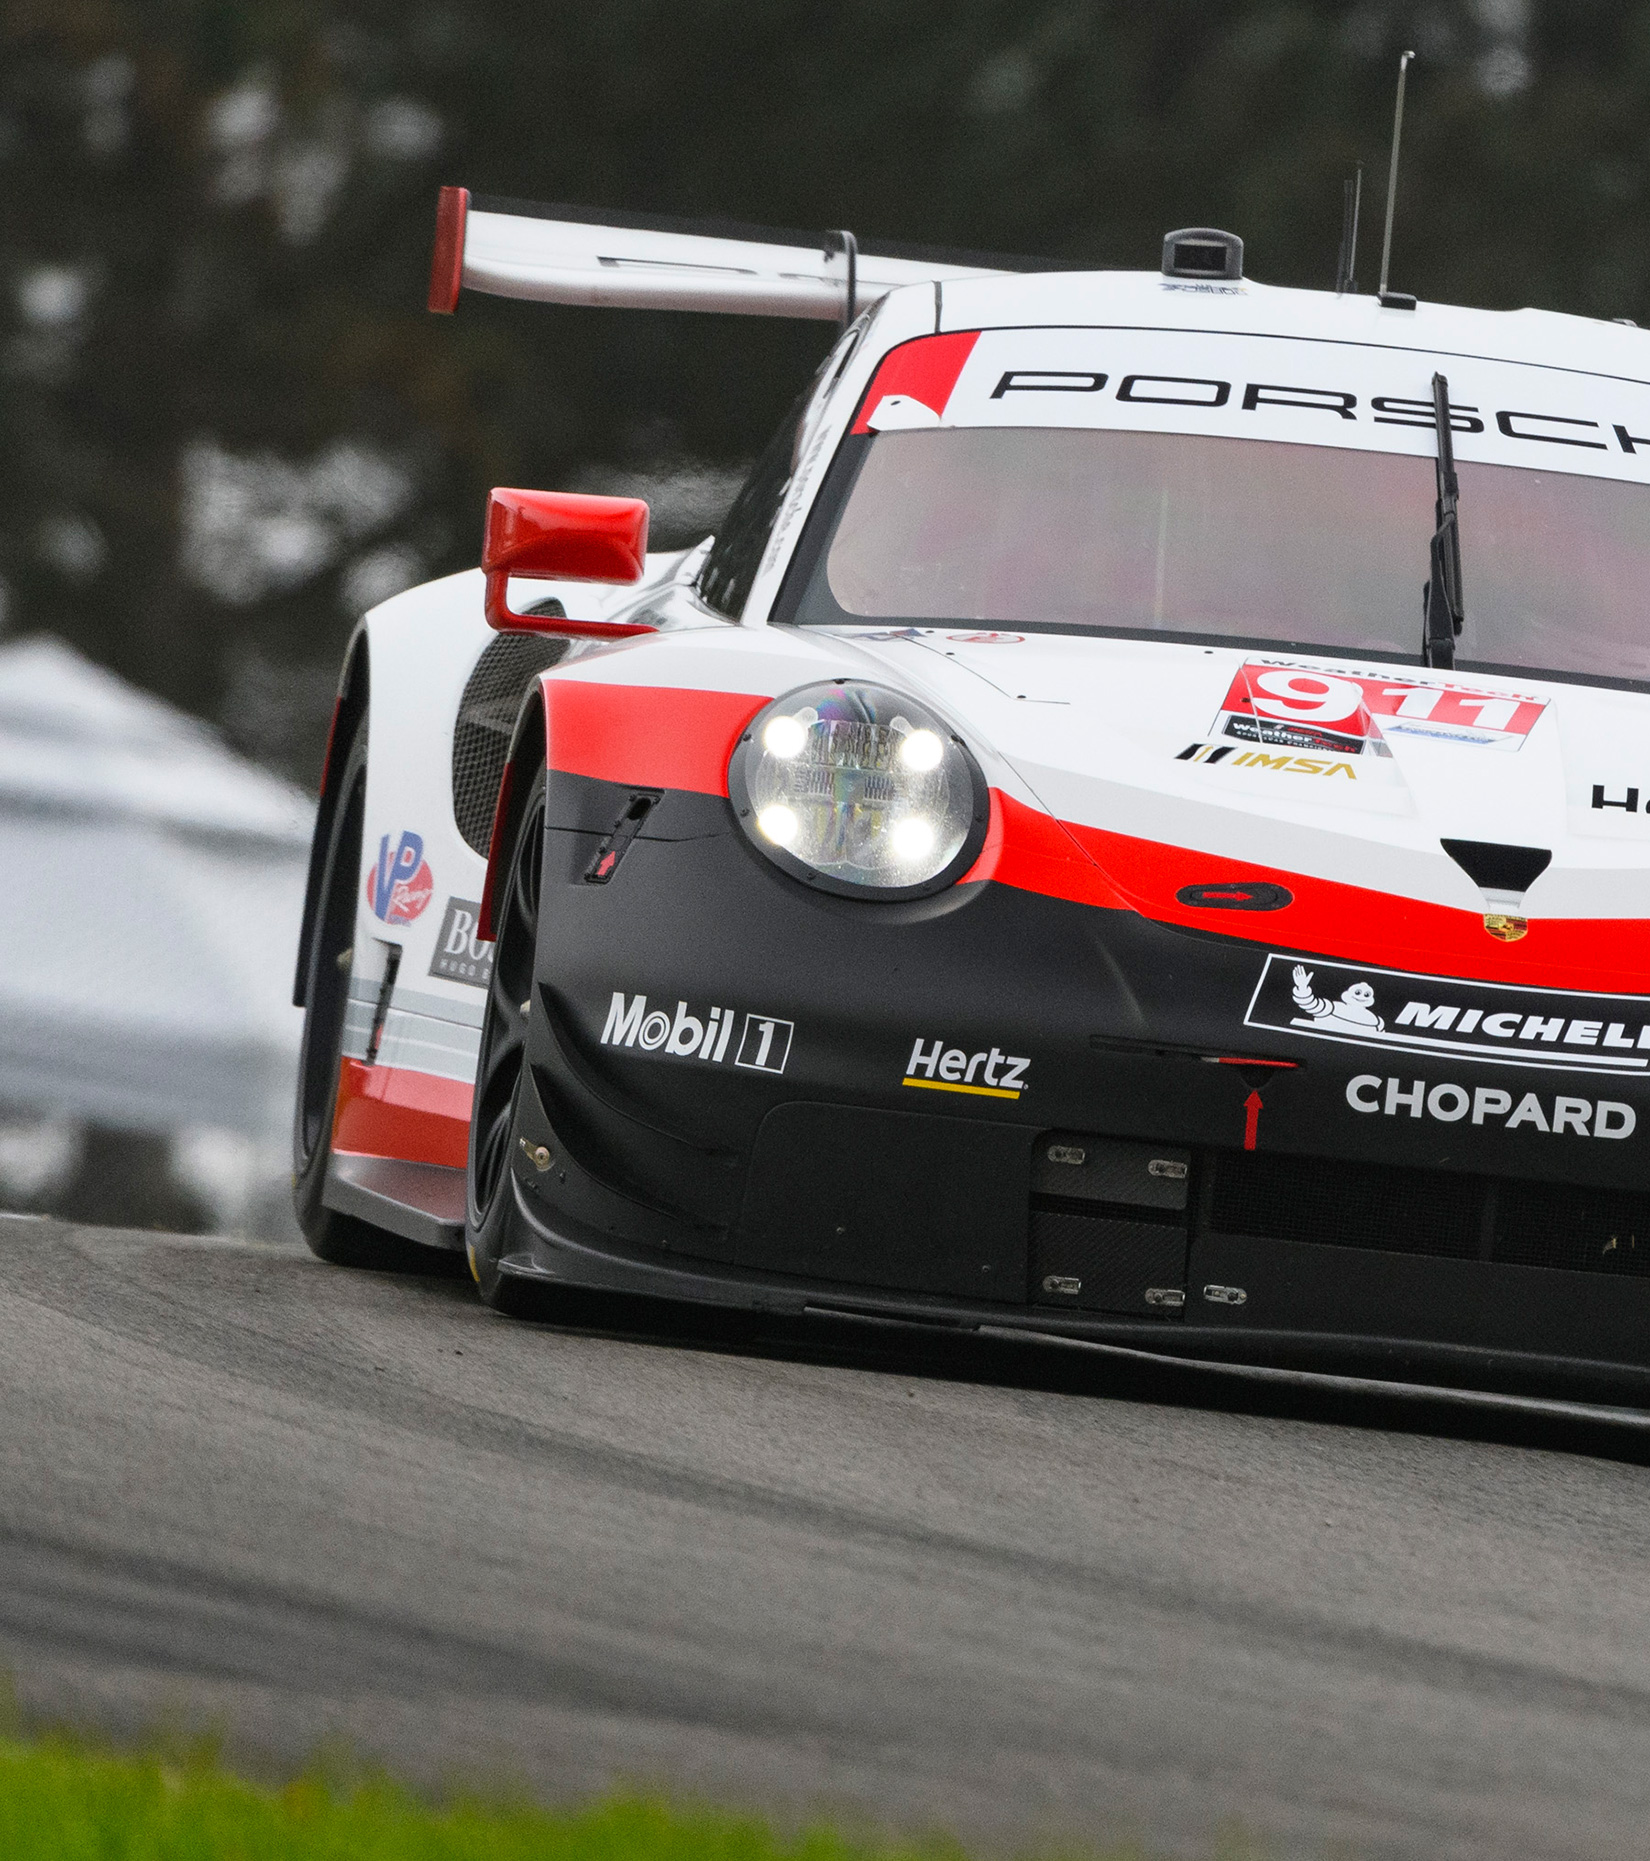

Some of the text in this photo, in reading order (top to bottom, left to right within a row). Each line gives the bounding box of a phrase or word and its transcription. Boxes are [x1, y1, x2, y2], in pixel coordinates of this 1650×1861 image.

[1256, 669, 1522, 731] 911
[1231, 752, 1357, 780] IMSA
[375, 830, 424, 921] VP
[444, 909, 495, 963] BO
[600, 992, 776, 1067] Mobil 1
[906, 1038, 1031, 1089] Hertz
[1346, 1074, 1637, 1140] CHOPARD
